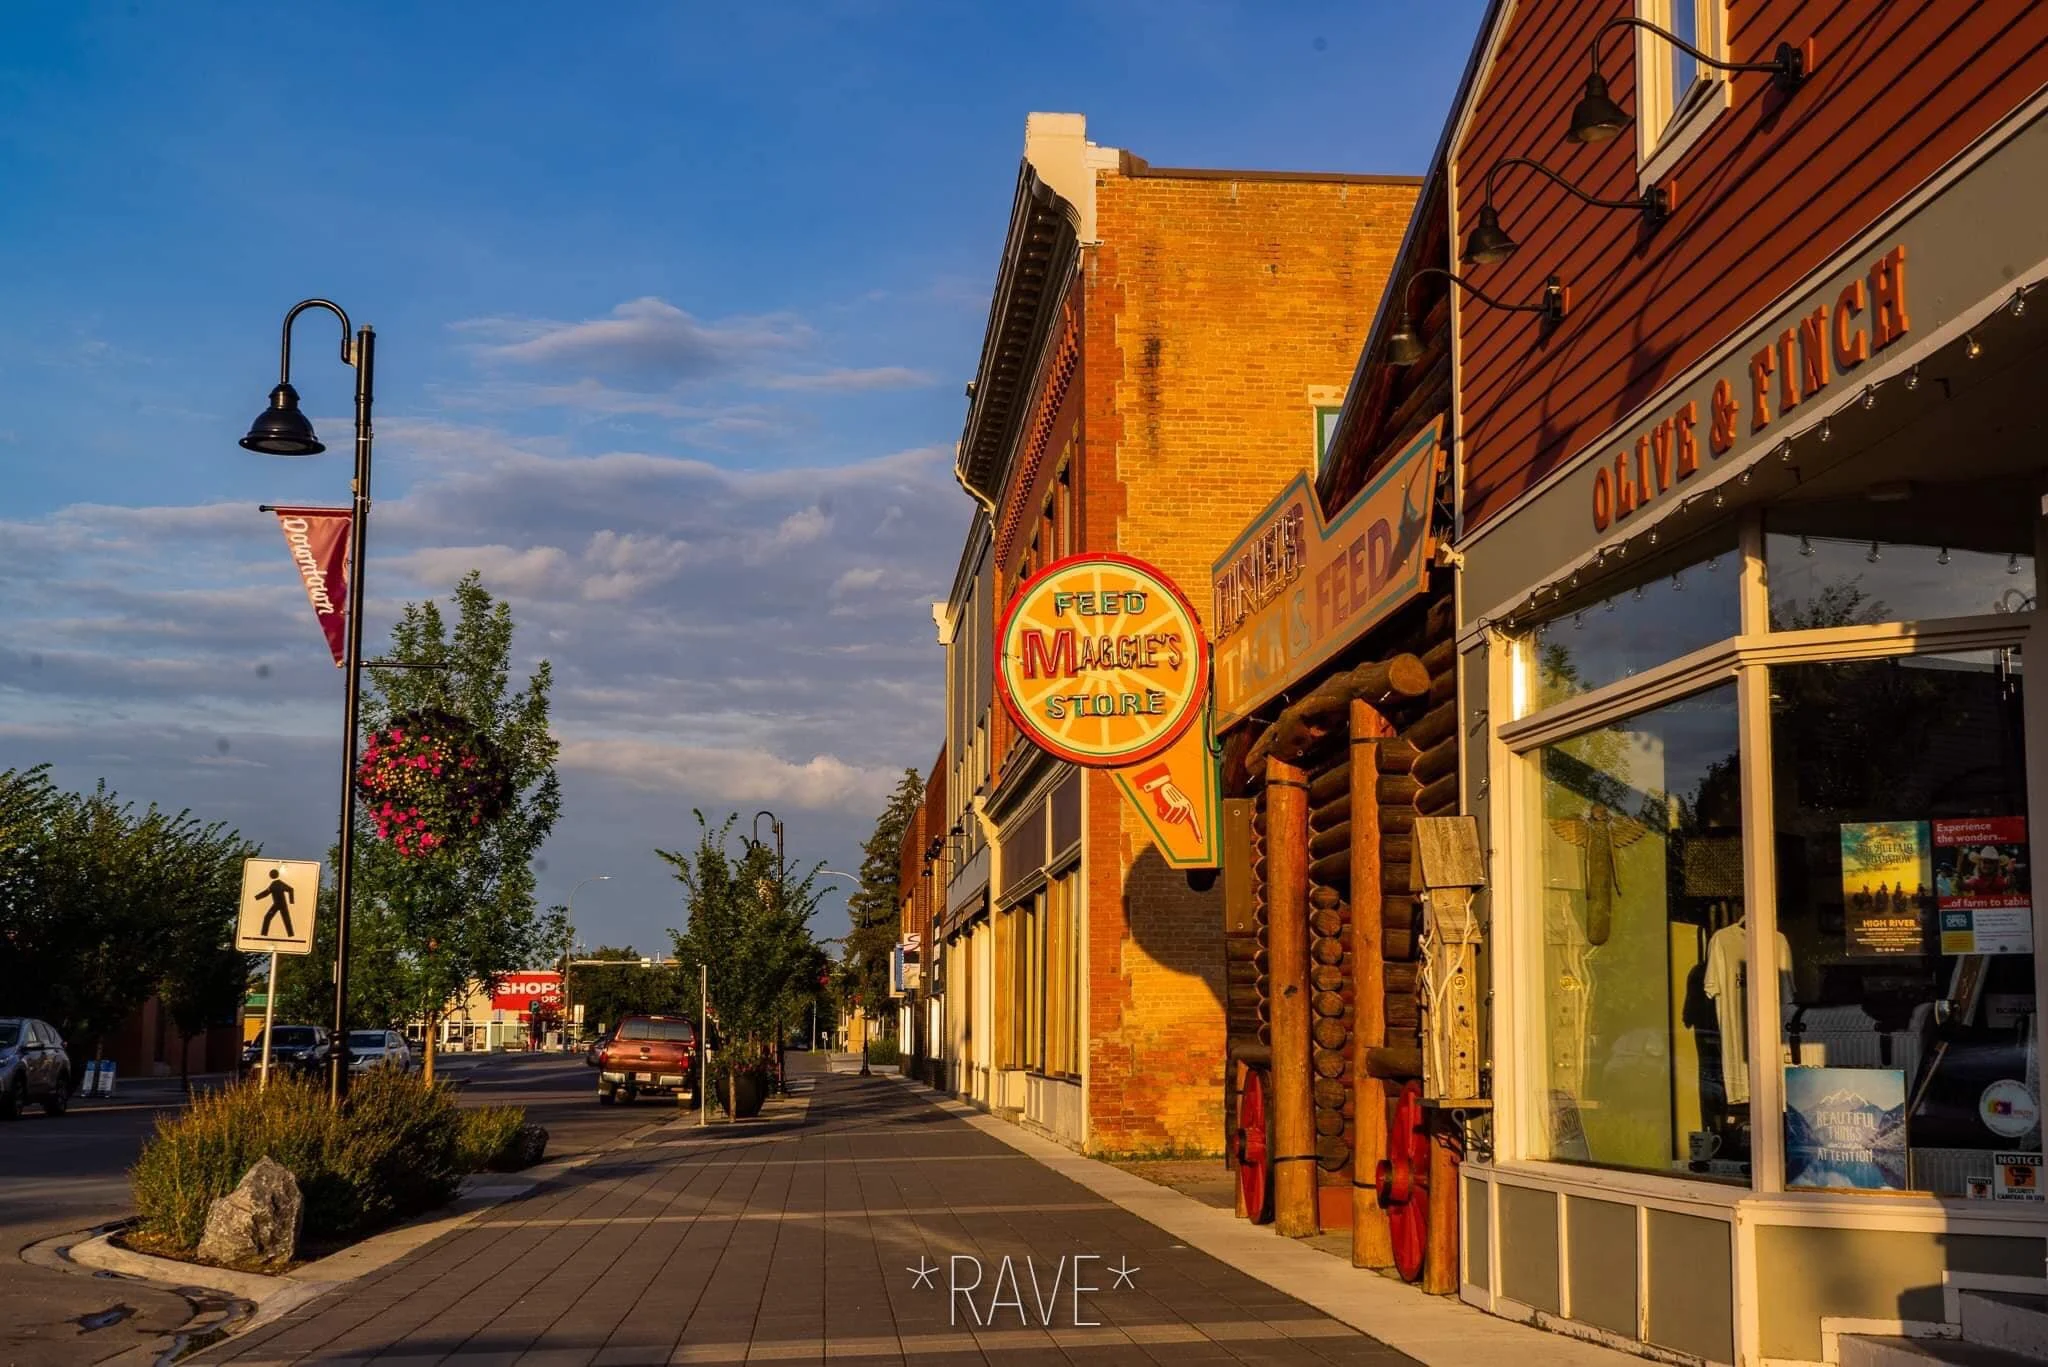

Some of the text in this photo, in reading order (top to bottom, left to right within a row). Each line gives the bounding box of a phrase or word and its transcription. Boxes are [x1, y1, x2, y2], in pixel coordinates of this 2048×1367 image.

[1592, 243, 1910, 532] OLIVE & FINCH
[282, 517, 336, 616] Downtown
[1054, 591, 1148, 618] FEED
[1222, 517, 1393, 705] TACK & FEED
[1020, 627, 1184, 681] MAGGIE'S
[1045, 688, 1168, 720] STORE
[1936, 823, 1992, 834] Experience
[1936, 834, 1955, 844] the
[1963, 898, 1988, 908] farm
[1990, 898, 2001, 907] to
[2003, 896, 2030, 906] table
[1863, 919, 1916, 928] HIGH RIVER
[1816, 1111, 1876, 1130] BEAUTIFUL
[1827, 1125, 1862, 1142] THINGS
[1817, 1148, 1873, 1163] ATTENTION
[1998, 1155, 2042, 1165] NOTICE
